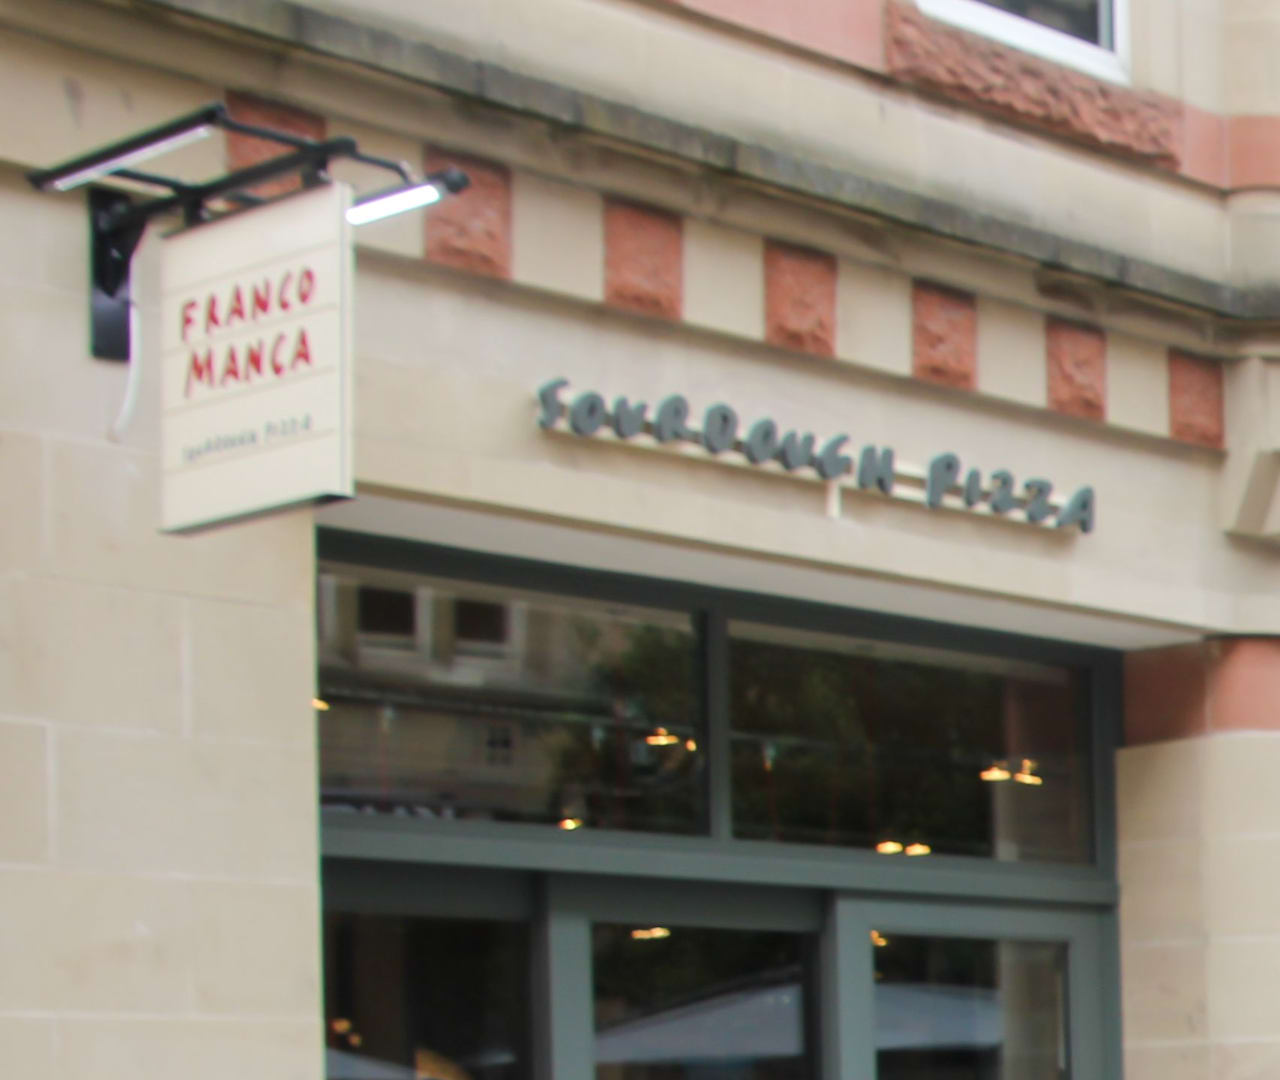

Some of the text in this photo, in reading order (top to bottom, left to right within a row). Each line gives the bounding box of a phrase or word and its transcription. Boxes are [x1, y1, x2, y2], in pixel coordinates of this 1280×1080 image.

[181, 267, 316, 343] FRANCO
[184, 326, 312, 399] MANCA
[538, 378, 1095, 533] SOURDOUGH PIZZA
